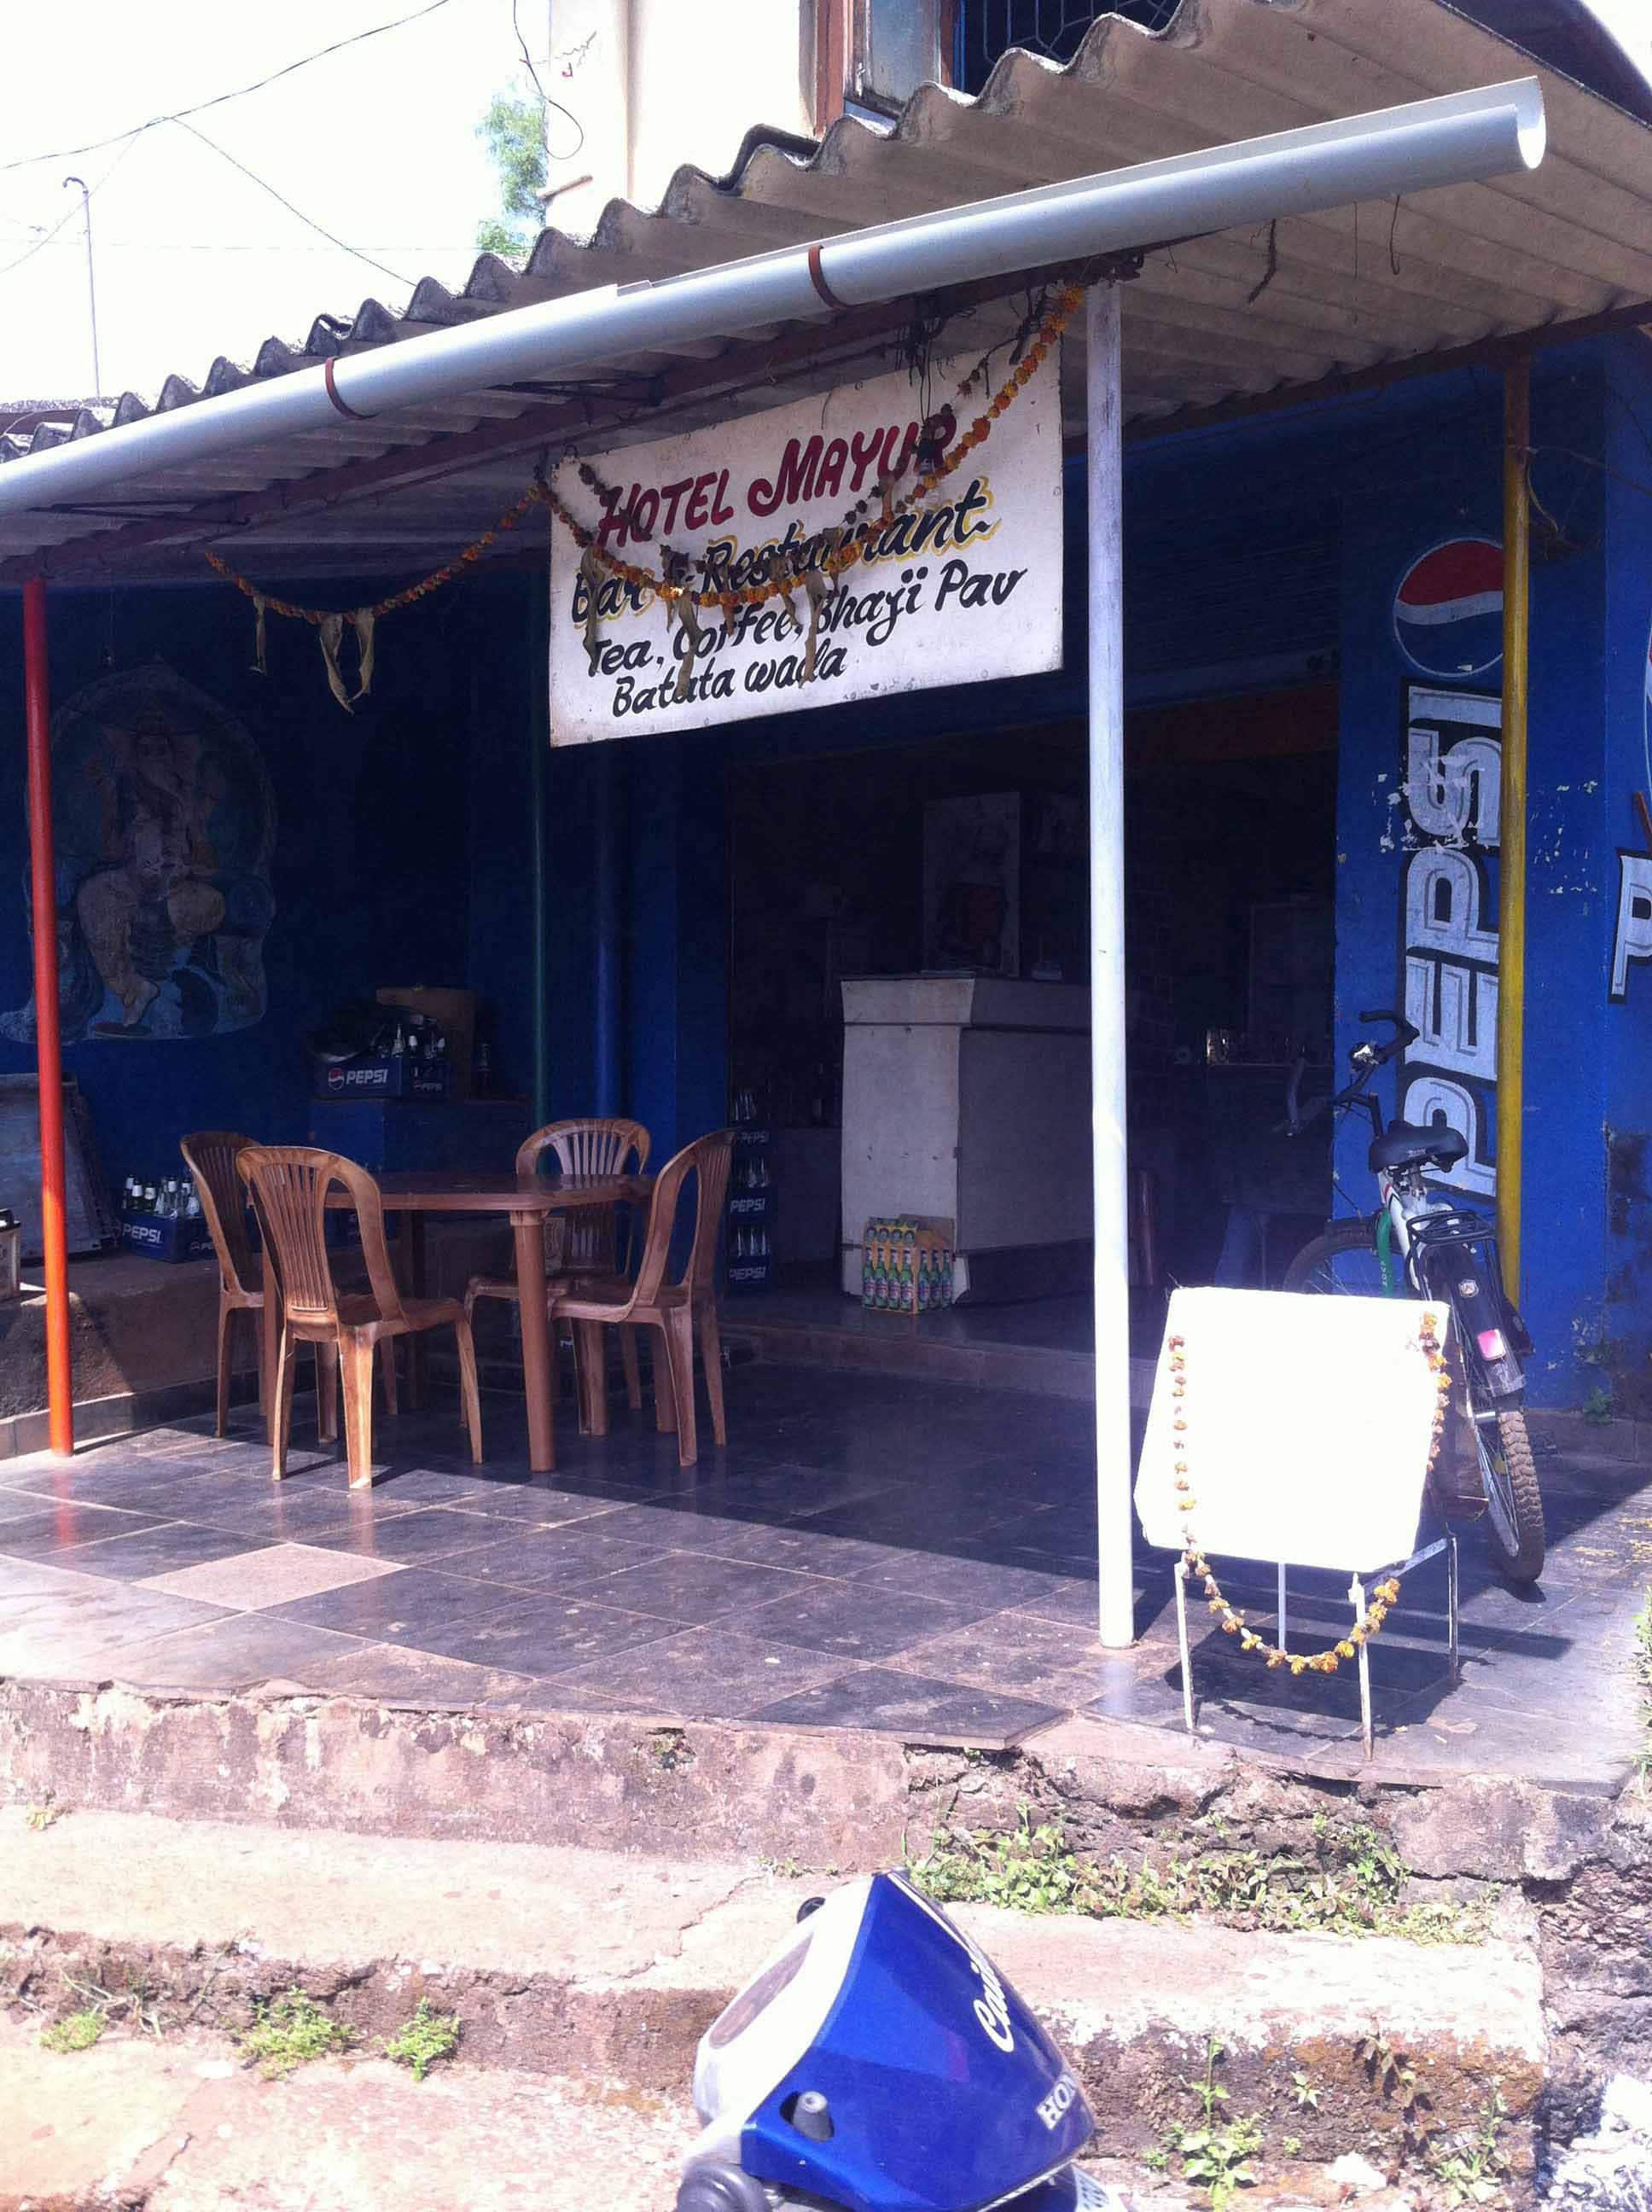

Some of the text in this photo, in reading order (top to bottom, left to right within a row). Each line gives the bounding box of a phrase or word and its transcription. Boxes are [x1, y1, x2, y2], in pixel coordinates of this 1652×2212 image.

[598, 413, 957, 548] HOTEL MAYUR
[935, 559, 1027, 611] Pav
[612, 656, 736, 718] Batata
[1404, 685, 1504, 1197] PEPSI
[345, 1068, 389, 1086] PEPSI
[730, 1197, 765, 1214] PEPSI
[122, 1222, 164, 1244] PEPSI
